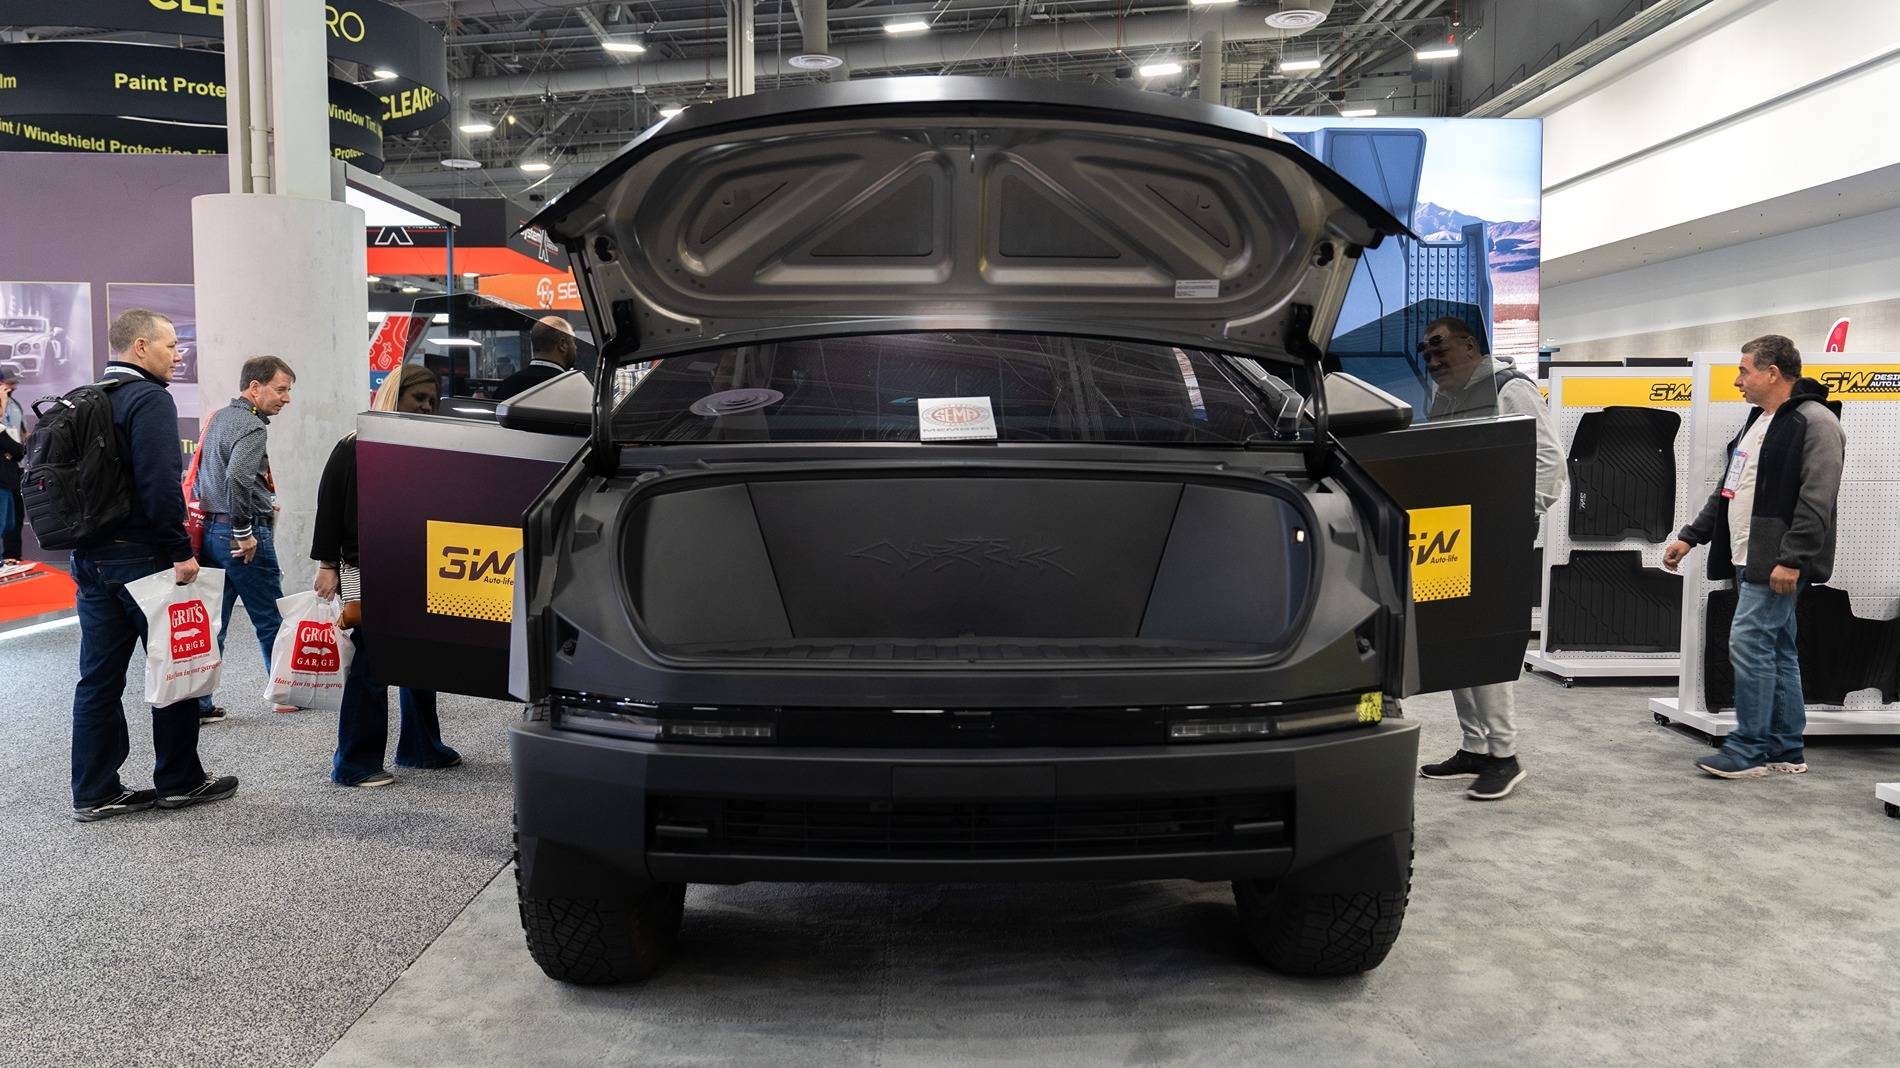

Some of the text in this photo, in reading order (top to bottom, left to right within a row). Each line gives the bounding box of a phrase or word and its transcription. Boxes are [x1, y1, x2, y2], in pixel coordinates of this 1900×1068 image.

[114, 73, 227, 97] Paint Prote
[23, 123, 105, 152] Windshield
[173, 639, 205, 653] GARGE
[297, 657, 334, 667] GARGE
[275, 677, 291, 685] Have
